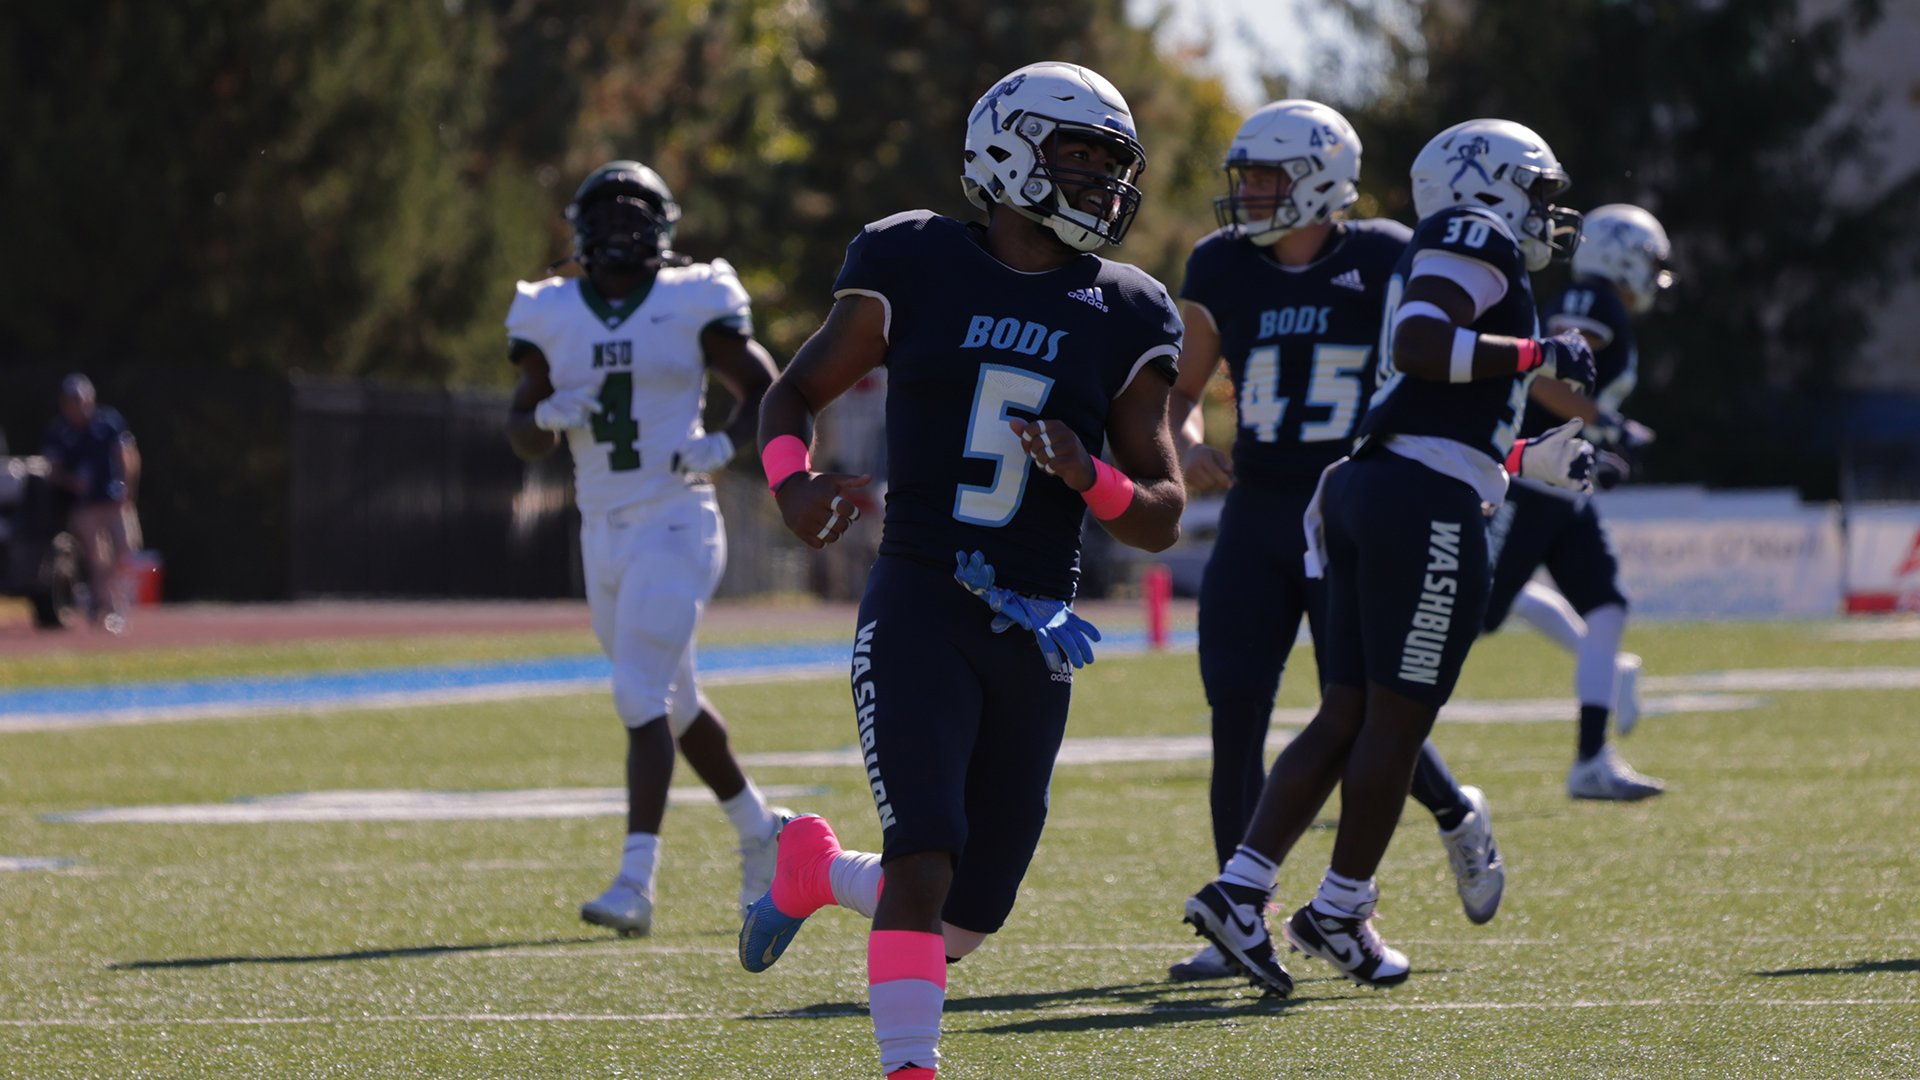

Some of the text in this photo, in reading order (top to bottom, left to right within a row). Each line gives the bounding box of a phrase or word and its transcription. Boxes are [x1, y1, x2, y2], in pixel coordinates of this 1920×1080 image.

[1310, 126, 1338, 147] 45
[1442, 217, 1490, 249] 30
[1067, 291, 1109, 313] adidas
[1257, 305, 1333, 339] BODS
[592, 340, 632, 368] NSU
[959, 315, 1069, 362] BODS
[1239, 342, 1373, 442] 45
[590, 371, 641, 470] 4
[952, 362, 1056, 528] 5
[1398, 520, 1461, 685] WASHBURN
